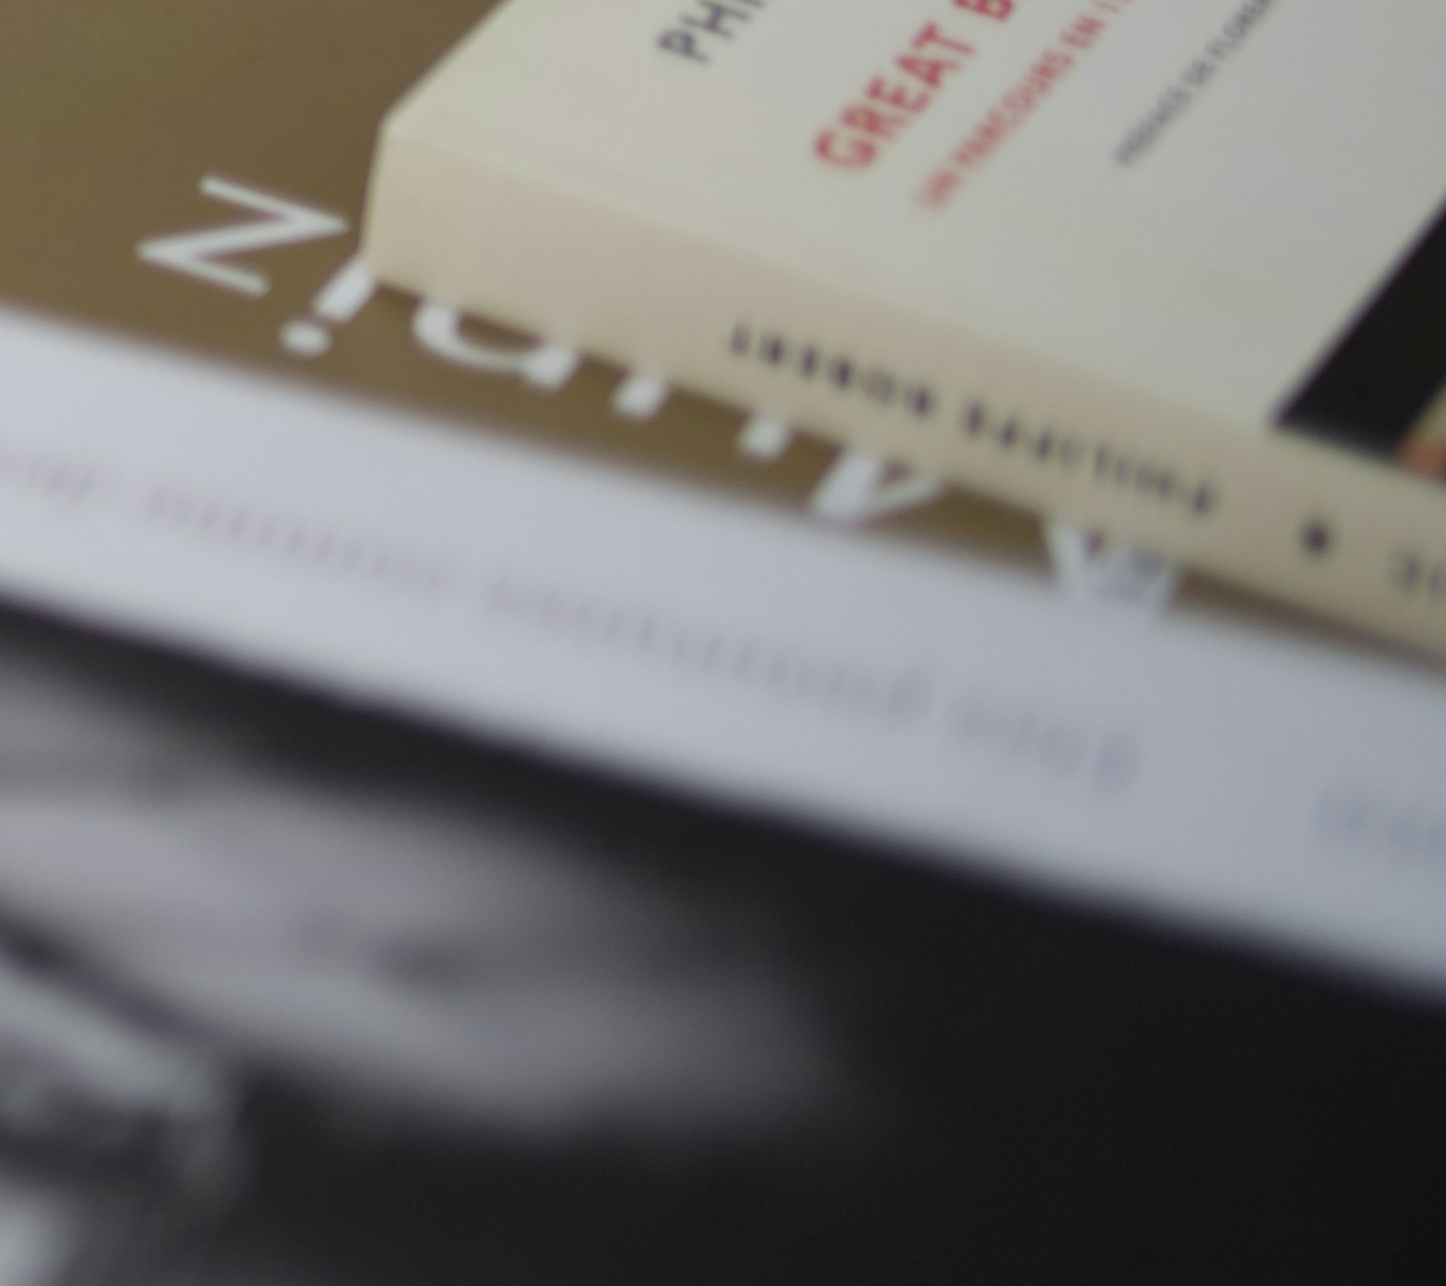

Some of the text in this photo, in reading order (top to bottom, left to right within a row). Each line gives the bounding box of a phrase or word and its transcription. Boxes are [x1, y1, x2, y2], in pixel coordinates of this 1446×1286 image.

[813, 21, 980, 177] GREAT
[954, 48, 1079, 173] PARCOURS
[1059, 13, 1106, 54] EN
